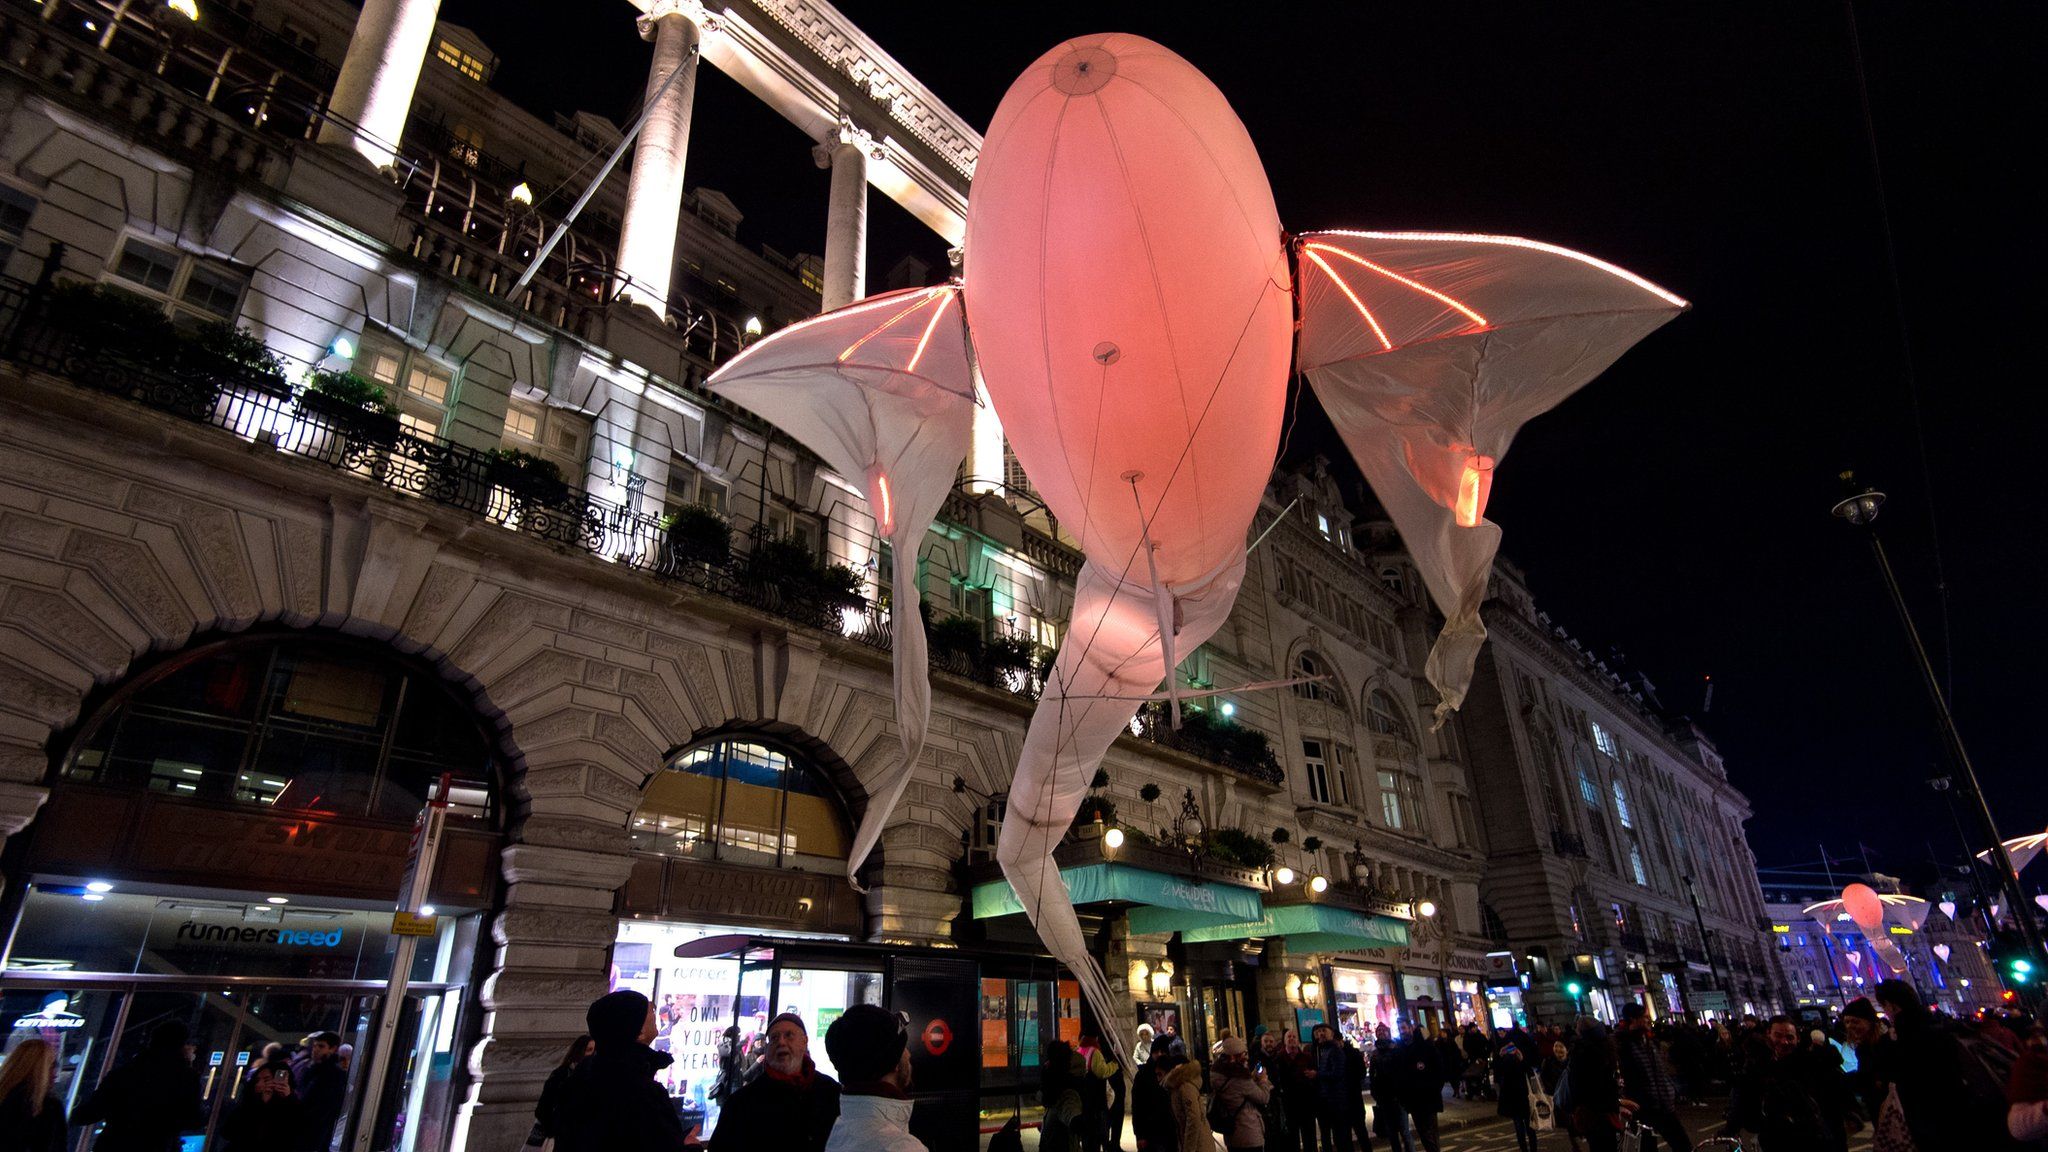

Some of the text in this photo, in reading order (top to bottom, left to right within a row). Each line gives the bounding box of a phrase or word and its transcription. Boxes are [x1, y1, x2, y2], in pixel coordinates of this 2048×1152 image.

[690, 1006, 719, 1023] OWN
[684, 1029, 722, 1046] YOUR
[682, 1053, 720, 1070] YEAR
